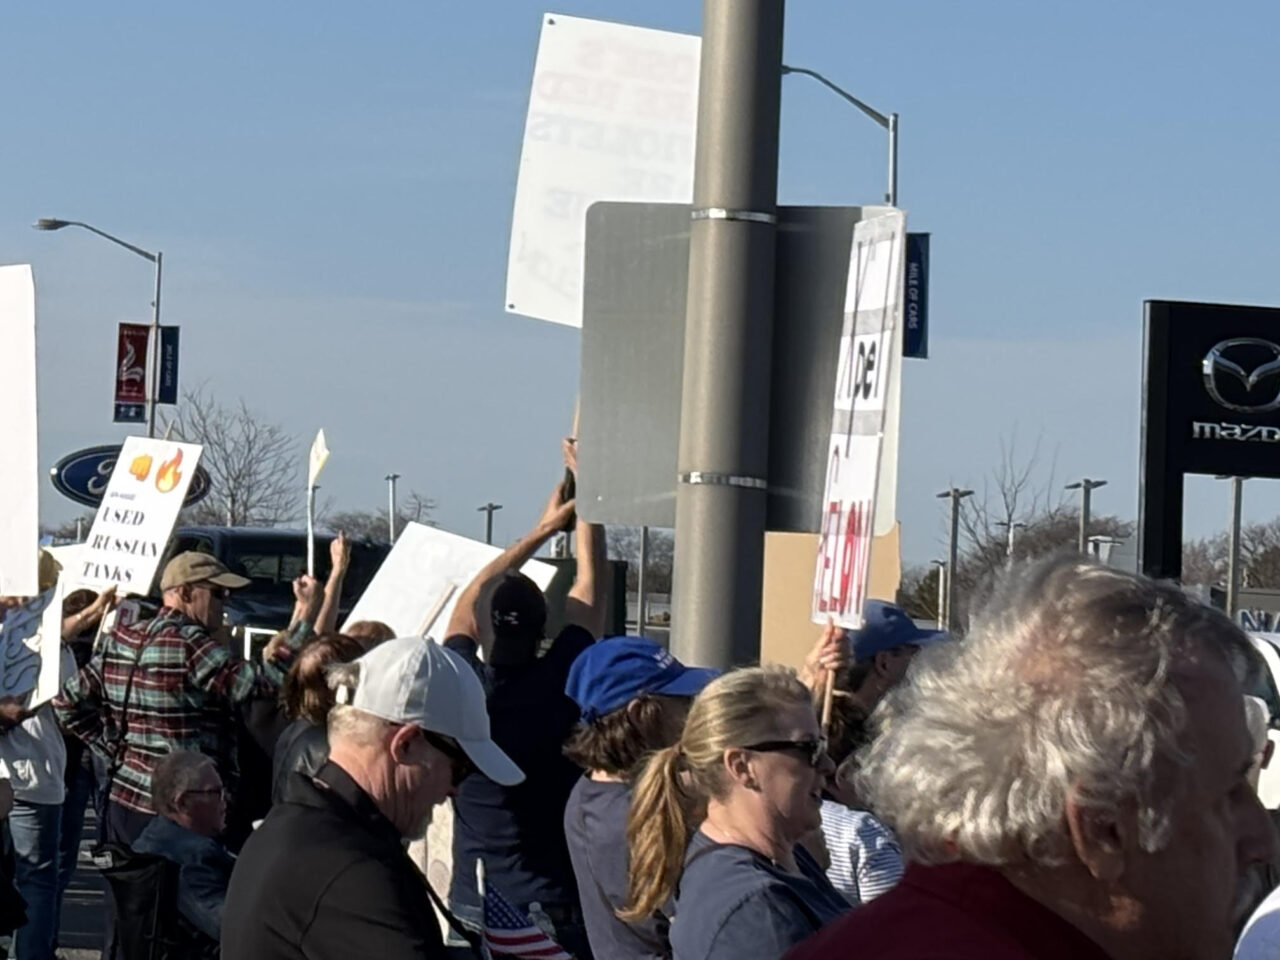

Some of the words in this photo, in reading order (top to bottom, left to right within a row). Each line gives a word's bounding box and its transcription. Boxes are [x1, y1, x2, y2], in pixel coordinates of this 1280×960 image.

[1191, 420, 1280, 443] mazd
[102, 506, 145, 526] USED
[91, 533, 157, 558] RUSSIAN
[82, 560, 134, 583] TANKS
